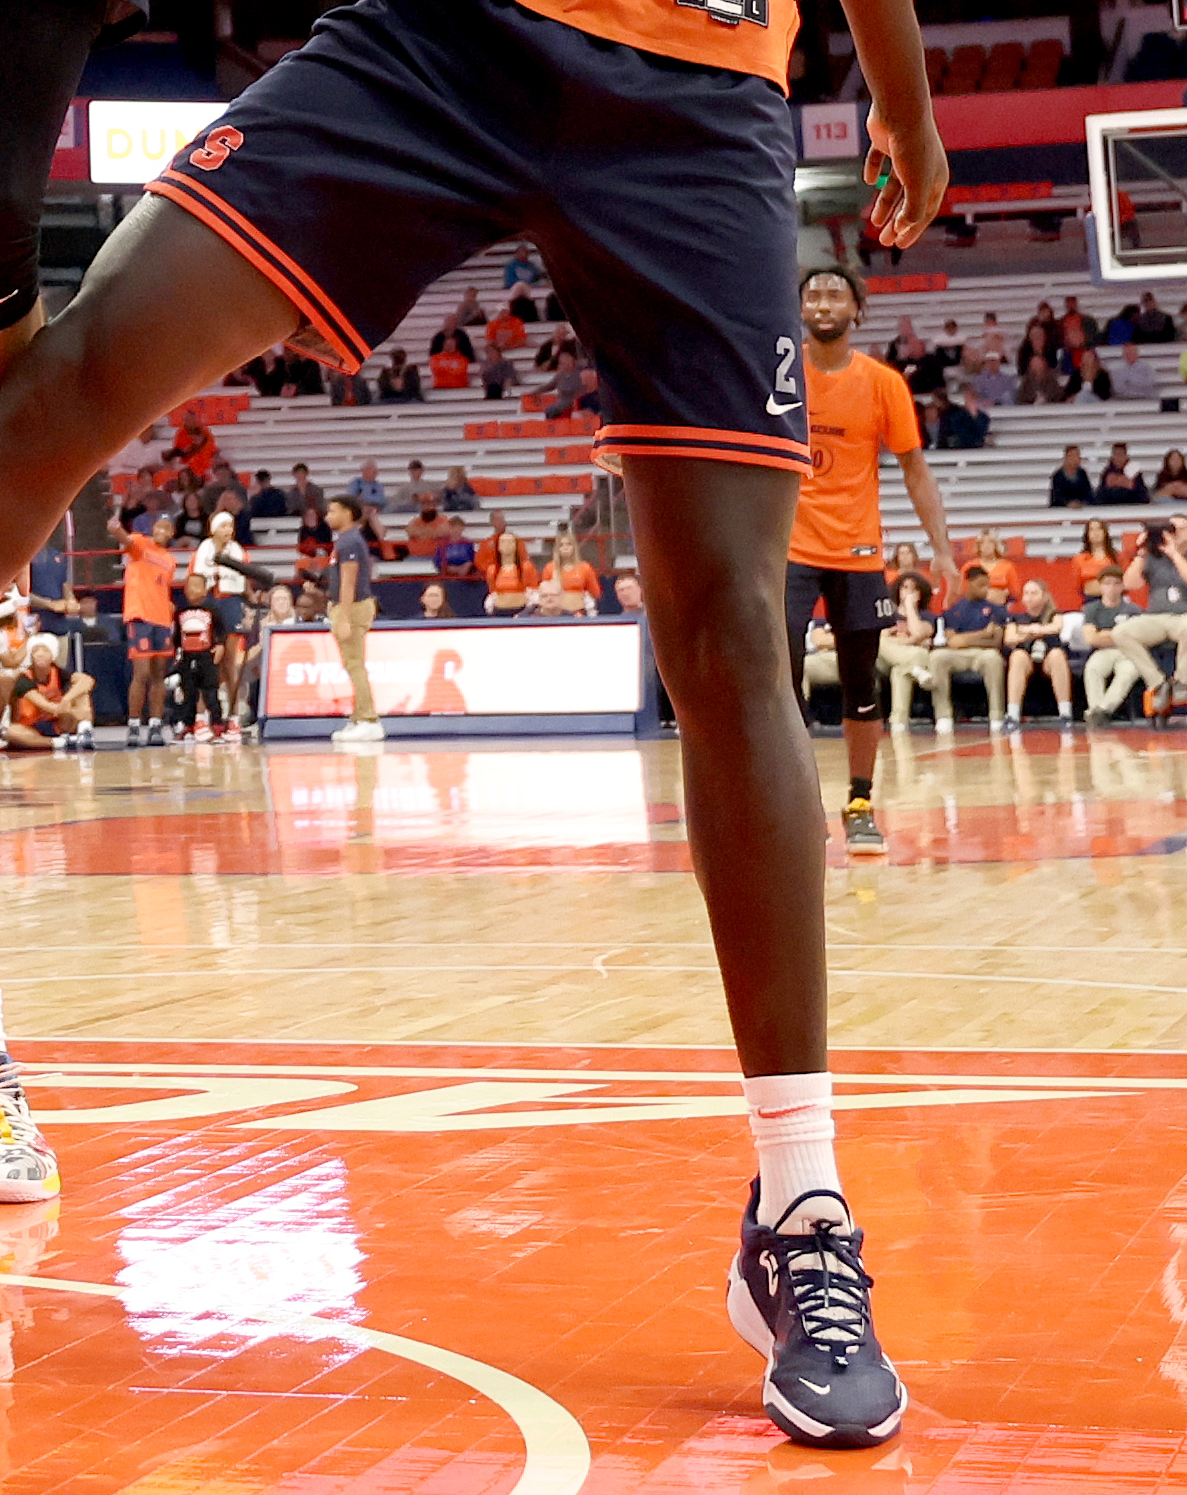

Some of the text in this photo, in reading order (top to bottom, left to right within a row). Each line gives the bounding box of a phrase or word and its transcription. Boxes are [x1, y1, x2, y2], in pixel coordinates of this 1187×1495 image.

[752, 0, 760, 15] L
[813, 121, 848, 141] 113
[774, 335, 797, 395] 2
[874, 597, 893, 618] 10
